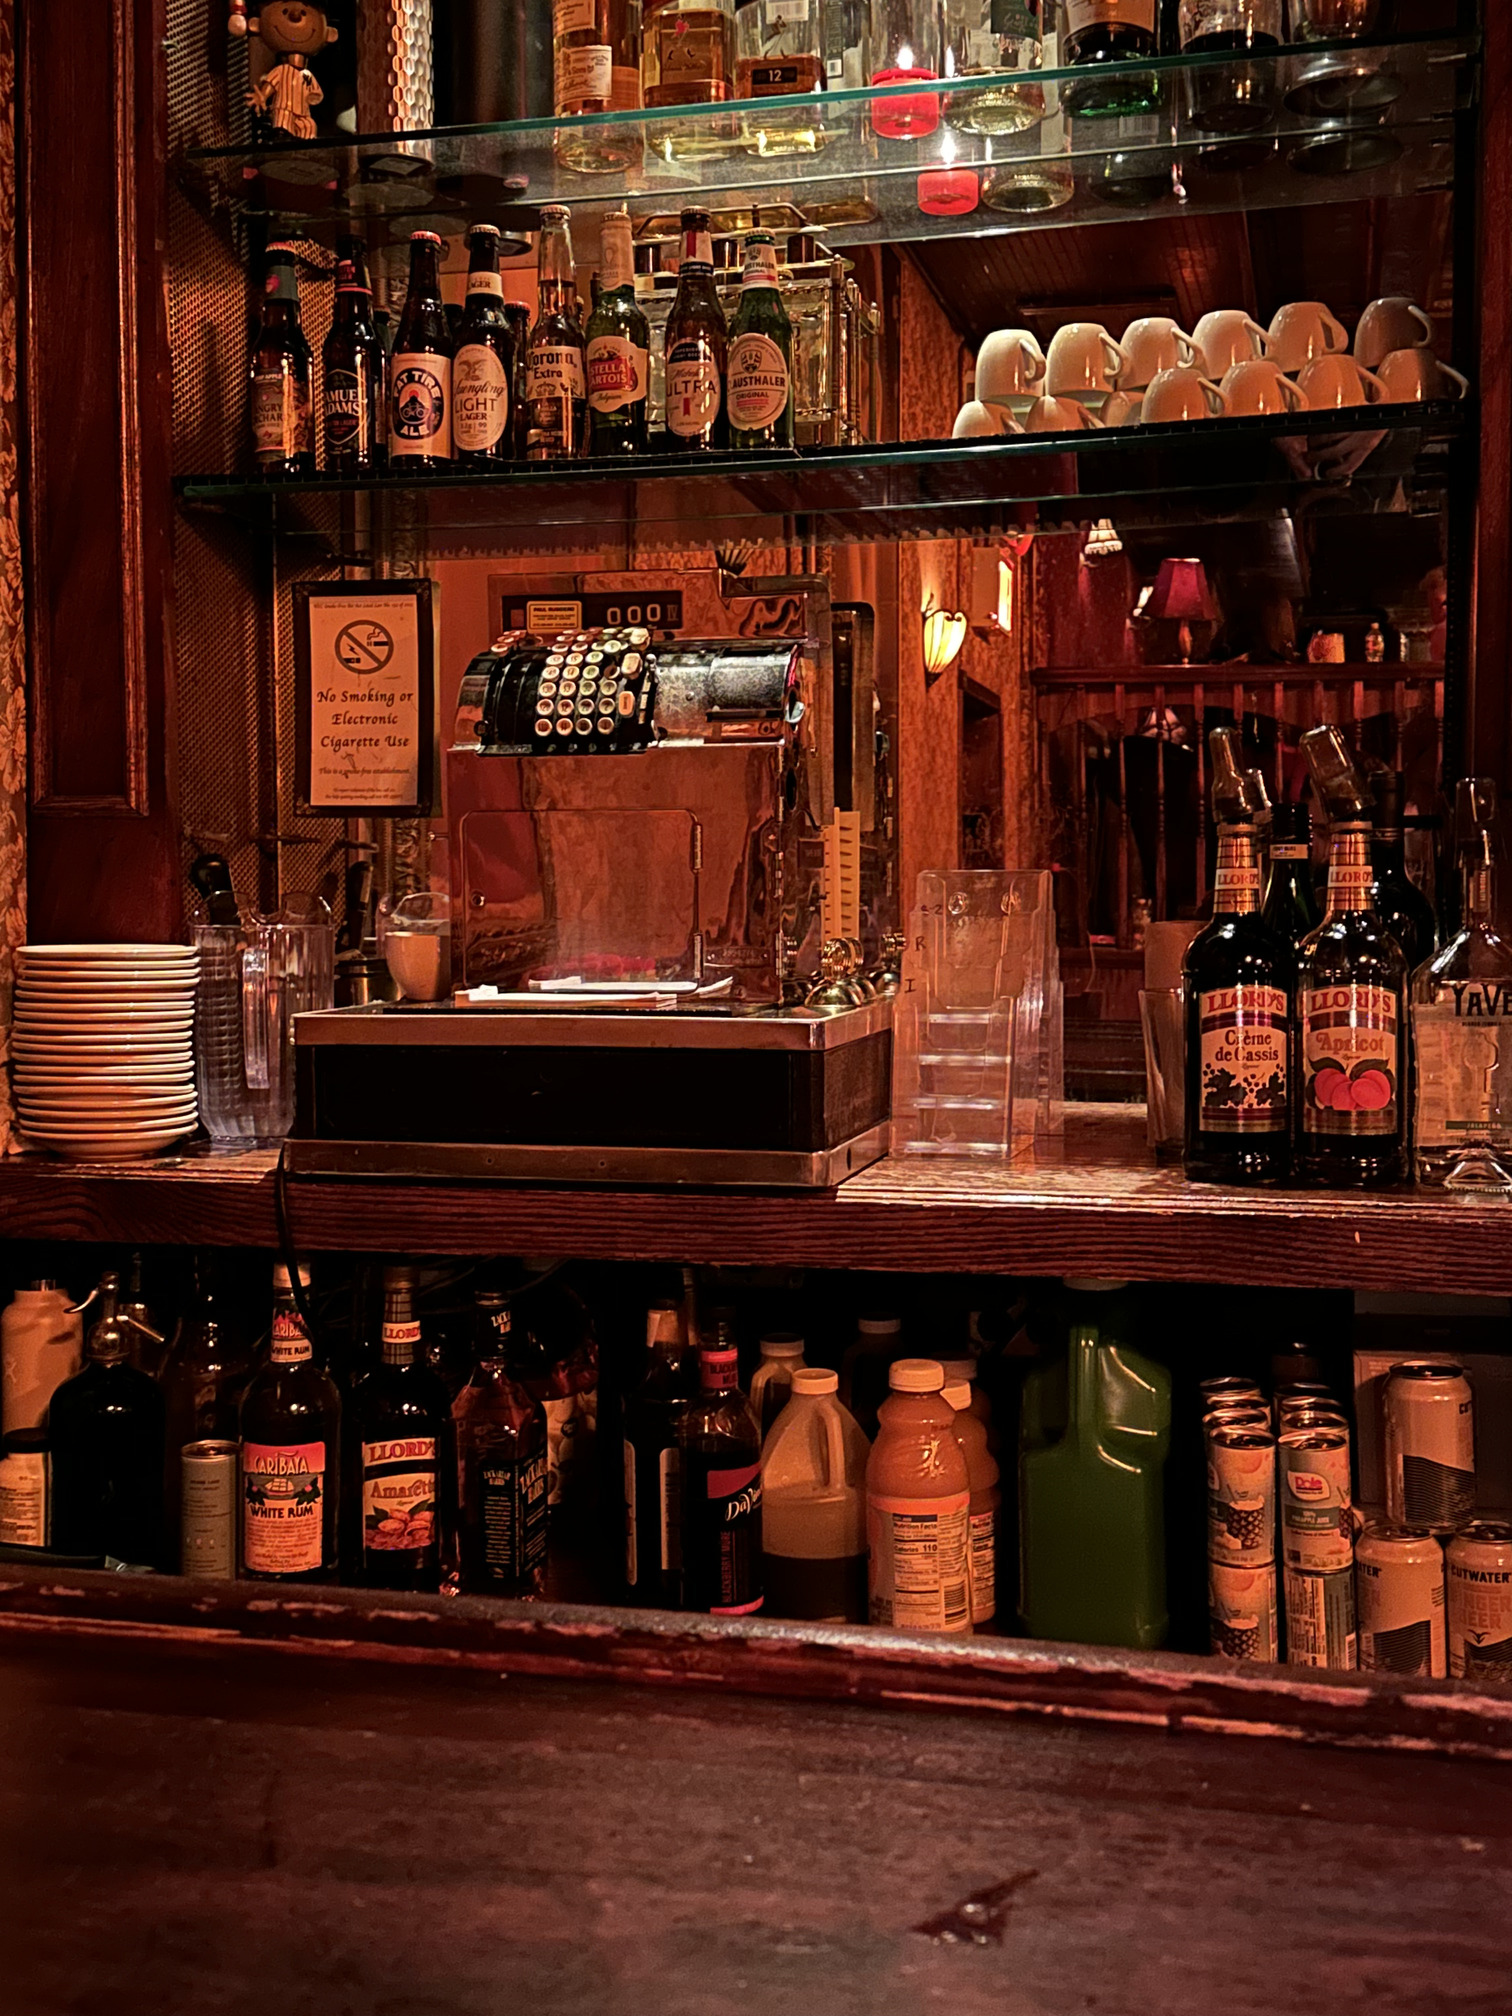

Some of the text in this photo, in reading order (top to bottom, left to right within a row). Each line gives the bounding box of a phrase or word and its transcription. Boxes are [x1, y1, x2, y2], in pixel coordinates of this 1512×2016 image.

[768, 69, 782, 82] 12
[470, 280, 491, 288] AGER
[534, 368, 562, 379] Extra
[590, 364, 626, 375] STELLA
[411, 371, 441, 398] TIRE
[590, 374, 627, 385] ARTOIS
[325, 388, 362, 402] AMUEL
[735, 392, 769, 400] ORIGINAL
[255, 403, 283, 413] NGRY
[455, 397, 498, 413] LIGHT
[460, 413, 488, 421] LAGER
[400, 424, 430, 436] ALE
[317, 688, 414, 707] No Smoking or
[331, 711, 398, 726] Electronic
[320, 736, 410, 752] Cigarette Use
[915, 936, 926, 951] R
[904, 978, 916, 993] I
[1208, 989, 1284, 1014] LLORD'S
[1310, 990, 1391, 1013] LLORD'S
[1225, 1029, 1271, 1046] Crème
[1316, 1031, 1385, 1055] Apricot
[1215, 1047, 1279, 1062] de Cassis
[273, 1322, 304, 1337] ARIBA
[384, 1326, 420, 1339] LLORD
[272, 1346, 310, 1355] WHITE RUM
[370, 1479, 435, 1498] Amarett
[1295, 1476, 1323, 1487] Dole
[250, 1504, 313, 1518] WHITE RUM
[922, 1544, 938, 1552] 110
[1356, 1562, 1381, 1578] ATER
[1450, 1563, 1509, 1584] CUTWATER
